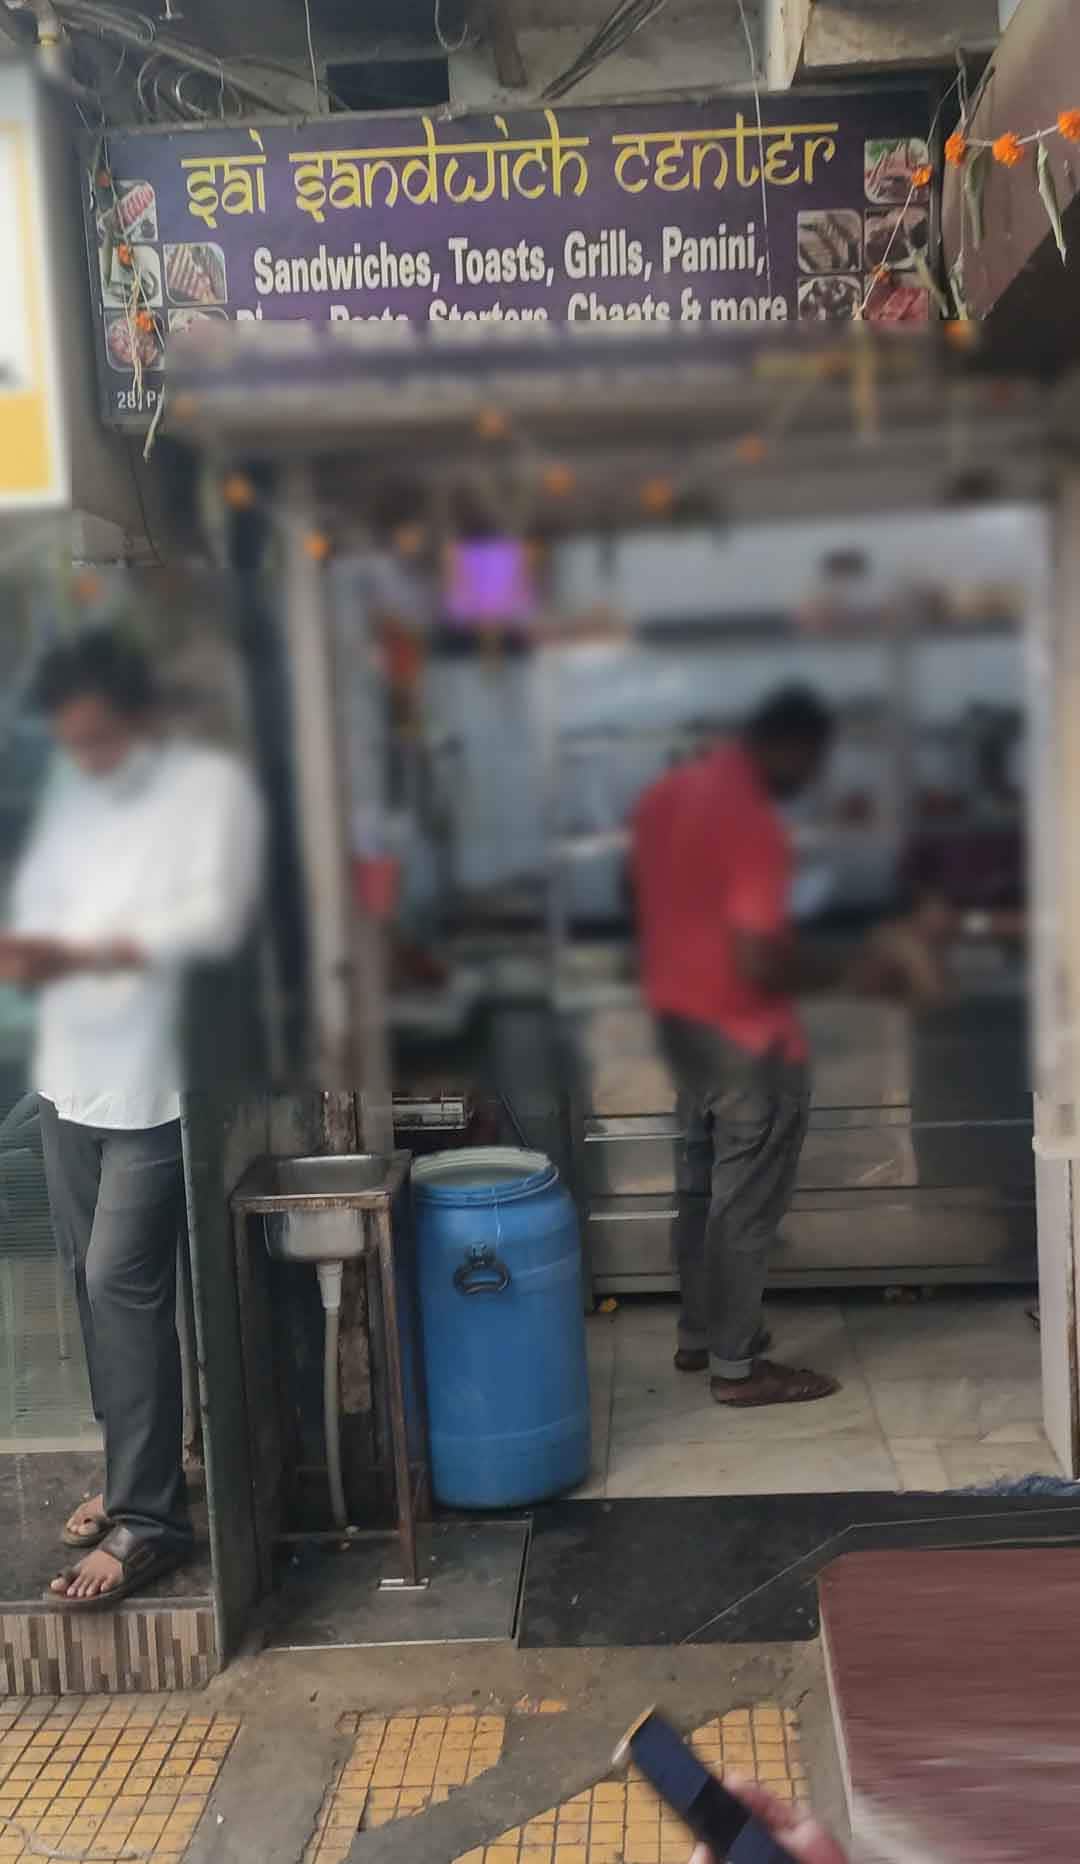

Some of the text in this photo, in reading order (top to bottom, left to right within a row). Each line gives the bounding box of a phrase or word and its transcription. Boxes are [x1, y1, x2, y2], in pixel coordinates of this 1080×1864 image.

[253, 221, 765, 295] Sandwiches, Toasts, Grills, Panini,
[710, 295, 788, 321] more
